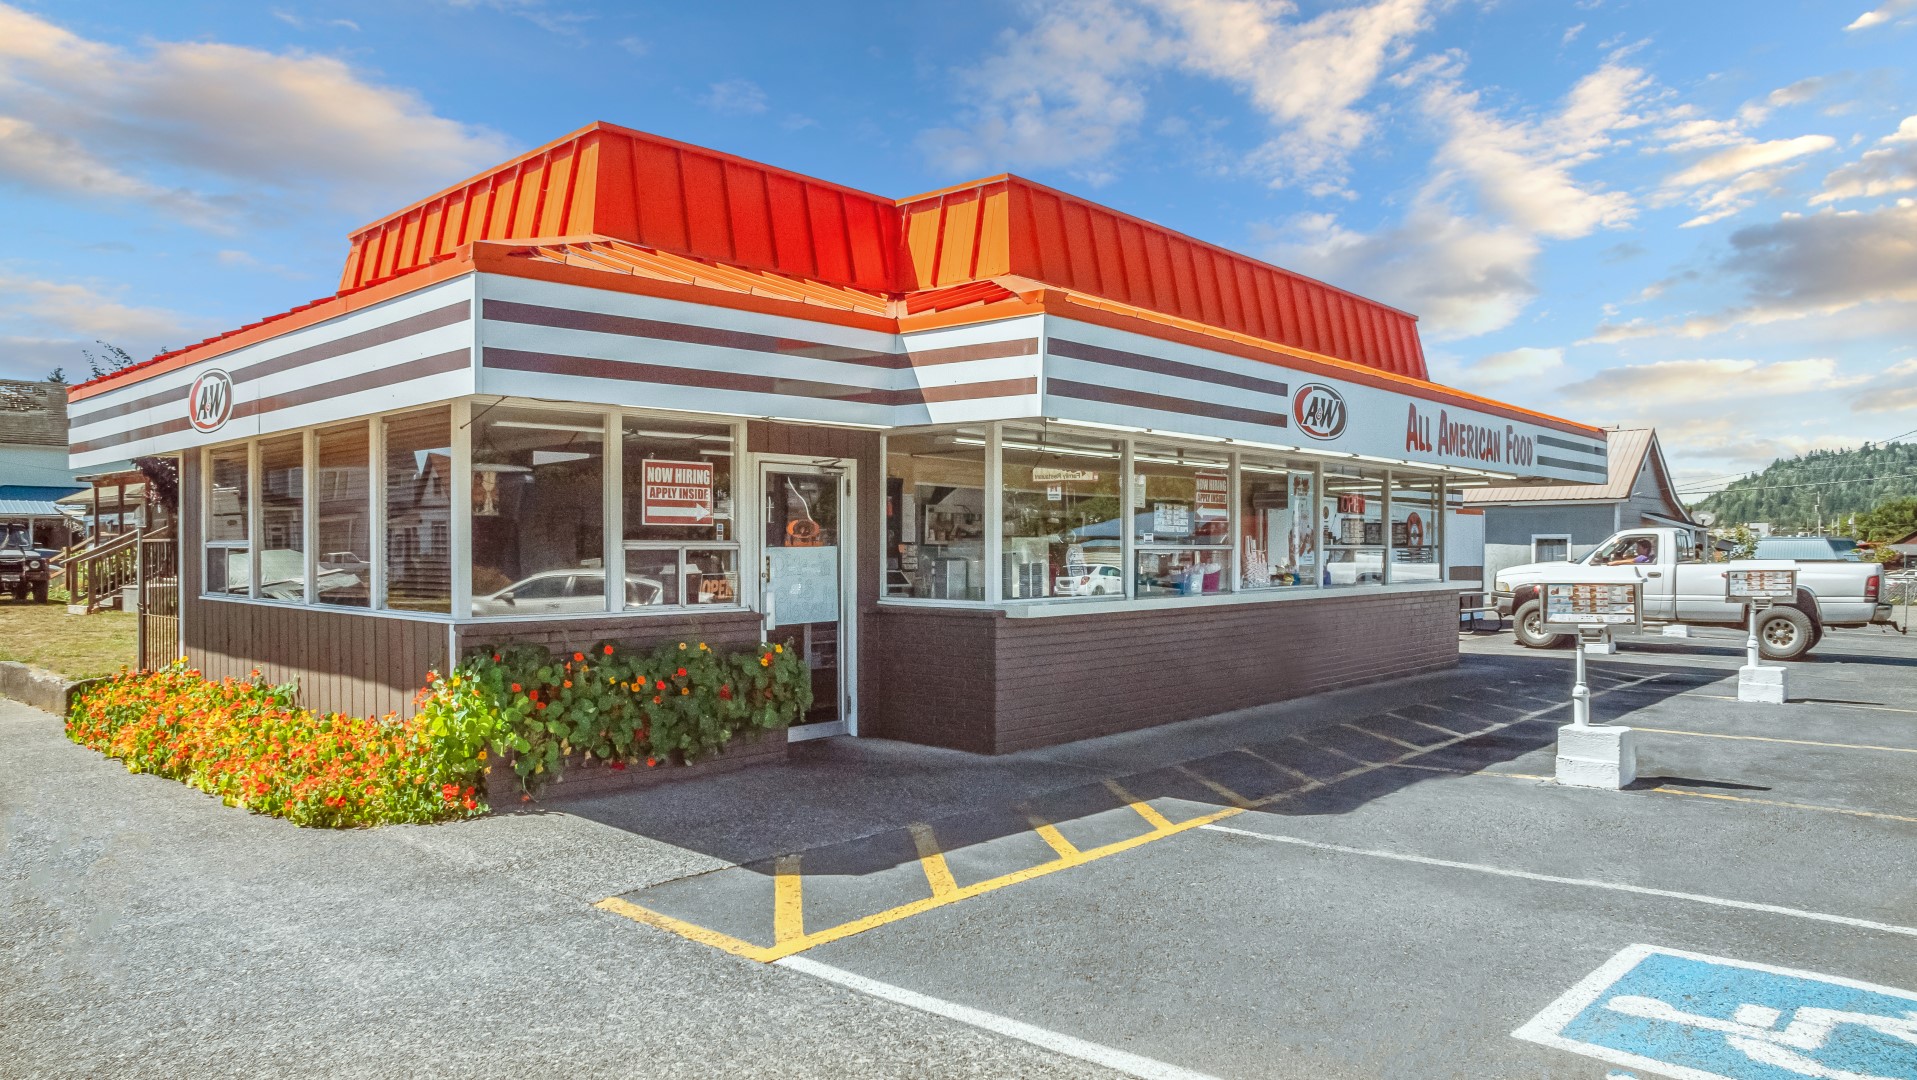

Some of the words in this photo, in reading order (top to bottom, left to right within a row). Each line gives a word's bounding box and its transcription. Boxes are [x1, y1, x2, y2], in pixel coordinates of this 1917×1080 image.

[1302, 396, 1340, 429] A&W
[1406, 402, 1432, 452] ALL
[1437, 408, 1501, 463] AMERICAN
[1506, 424, 1533, 467] FOOD
[647, 466, 673, 483] NOW
[675, 468, 710, 485] HIRING
[650, 487, 677, 499] APPLY
[679, 488, 709, 500] INSIDE
[1340, 494, 1366, 513] OPEN
